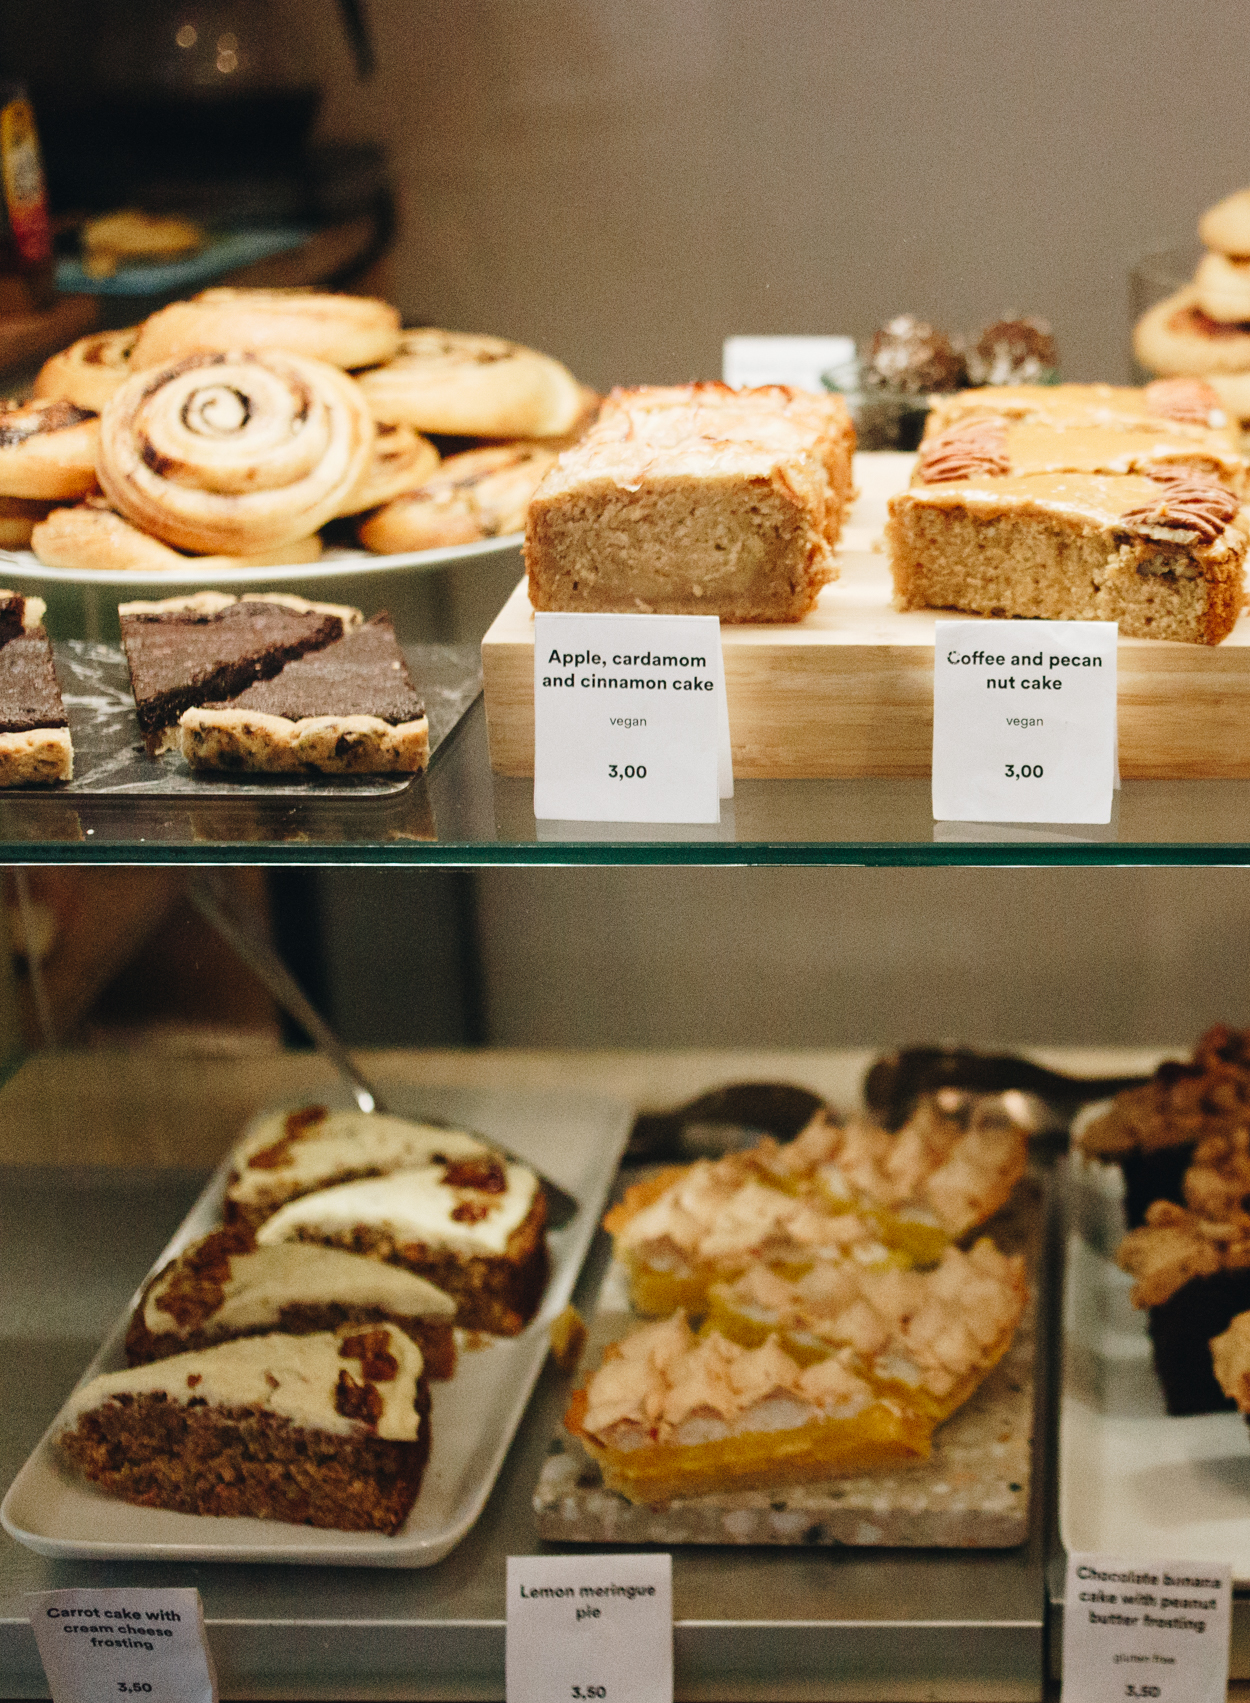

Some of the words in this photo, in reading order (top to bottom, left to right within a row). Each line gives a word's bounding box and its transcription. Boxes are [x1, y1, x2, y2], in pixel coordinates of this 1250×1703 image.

[548, 649, 607, 668] Apple,
[612, 651, 707, 668] cardamom
[947, 651, 1006, 666] Coffee
[1011, 651, 1043, 666] and
[1049, 655, 1103, 669] pecan
[542, 673, 575, 687] and
[580, 673, 667, 690] cinnamon
[672, 676, 714, 691] cake
[986, 676, 1016, 689] nut
[1020, 675, 1063, 690] cake
[609, 717, 647, 729] vegan
[1006, 717, 1044, 729] vegan
[608, 764, 647, 781] 3,00
[1005, 764, 1044, 781] 3,00
[1076, 1566, 1159, 1585] Chocolate
[520, 1584, 575, 1598] Lemon
[579, 1583, 656, 1600] meringue
[1079, 1590, 1117, 1604] cake
[1121, 1592, 1157, 1606] with
[1160, 1597, 1217, 1610] peanut
[47, 1607, 100, 1619] Carrot
[104, 1608, 142, 1620] cake
[145, 1609, 182, 1622] with
[576, 1604, 601, 1622] pie
[63, 1624, 114, 1633] cream
[117, 1624, 174, 1637] cheese
[1088, 1610, 1138, 1626] butter
[1142, 1613, 1206, 1634] frosting
[90, 1637, 154, 1651] frosting
[117, 1682, 153, 1694] 3,50
[571, 1685, 607, 1700] 3,50
